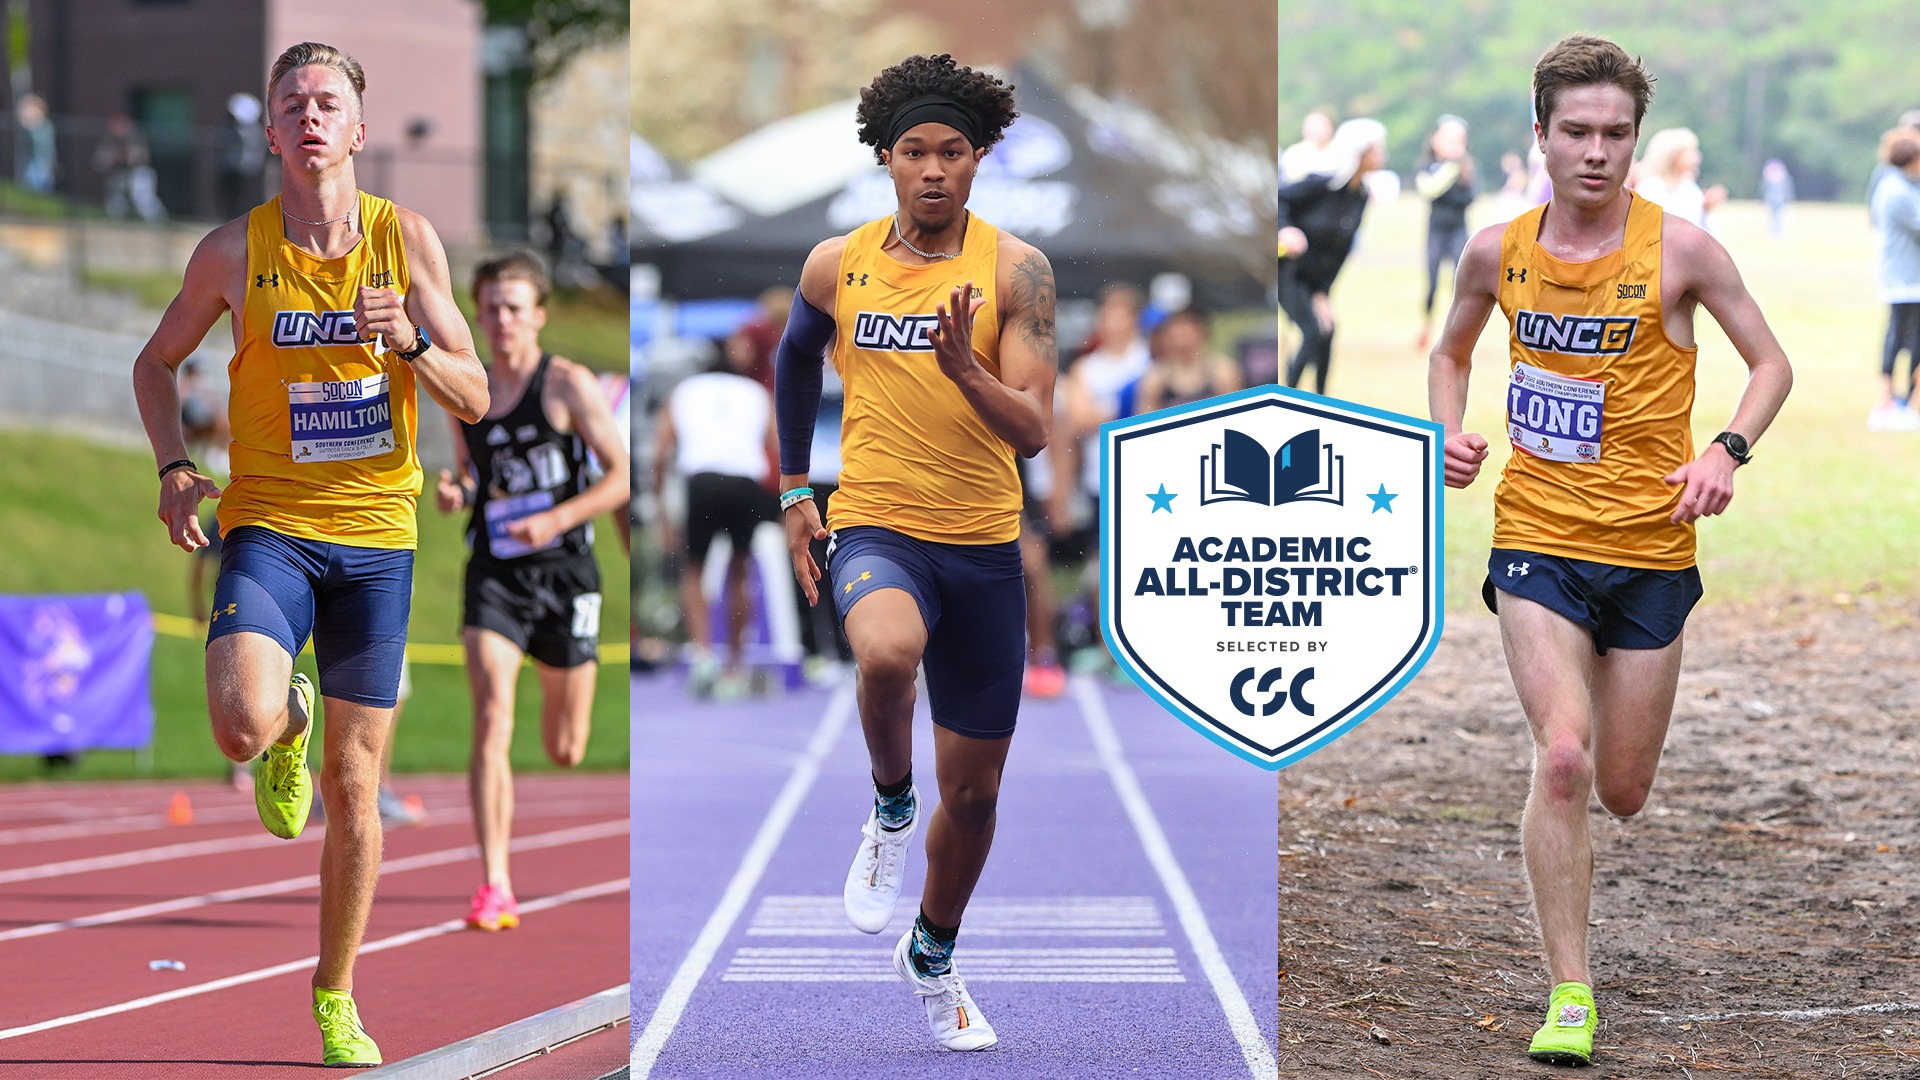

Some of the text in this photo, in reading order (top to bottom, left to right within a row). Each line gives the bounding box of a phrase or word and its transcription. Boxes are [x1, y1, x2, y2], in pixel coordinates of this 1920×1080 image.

[1617, 284, 1647, 299] SOCON
[272, 309, 366, 349] UNC
[853, 311, 946, 353] UNC
[1516, 309, 1640, 356] UNCG
[322, 378, 363, 401] SOCON
[1536, 378, 1563, 390] SOUTHERN
[1563, 384, 1601, 396] CONFERENCE
[293, 401, 390, 431] HAMILTON
[1511, 387, 1598, 439] LONG
[315, 440, 343, 449] SOUTHERN
[343, 436, 376, 447] CONFERENCE
